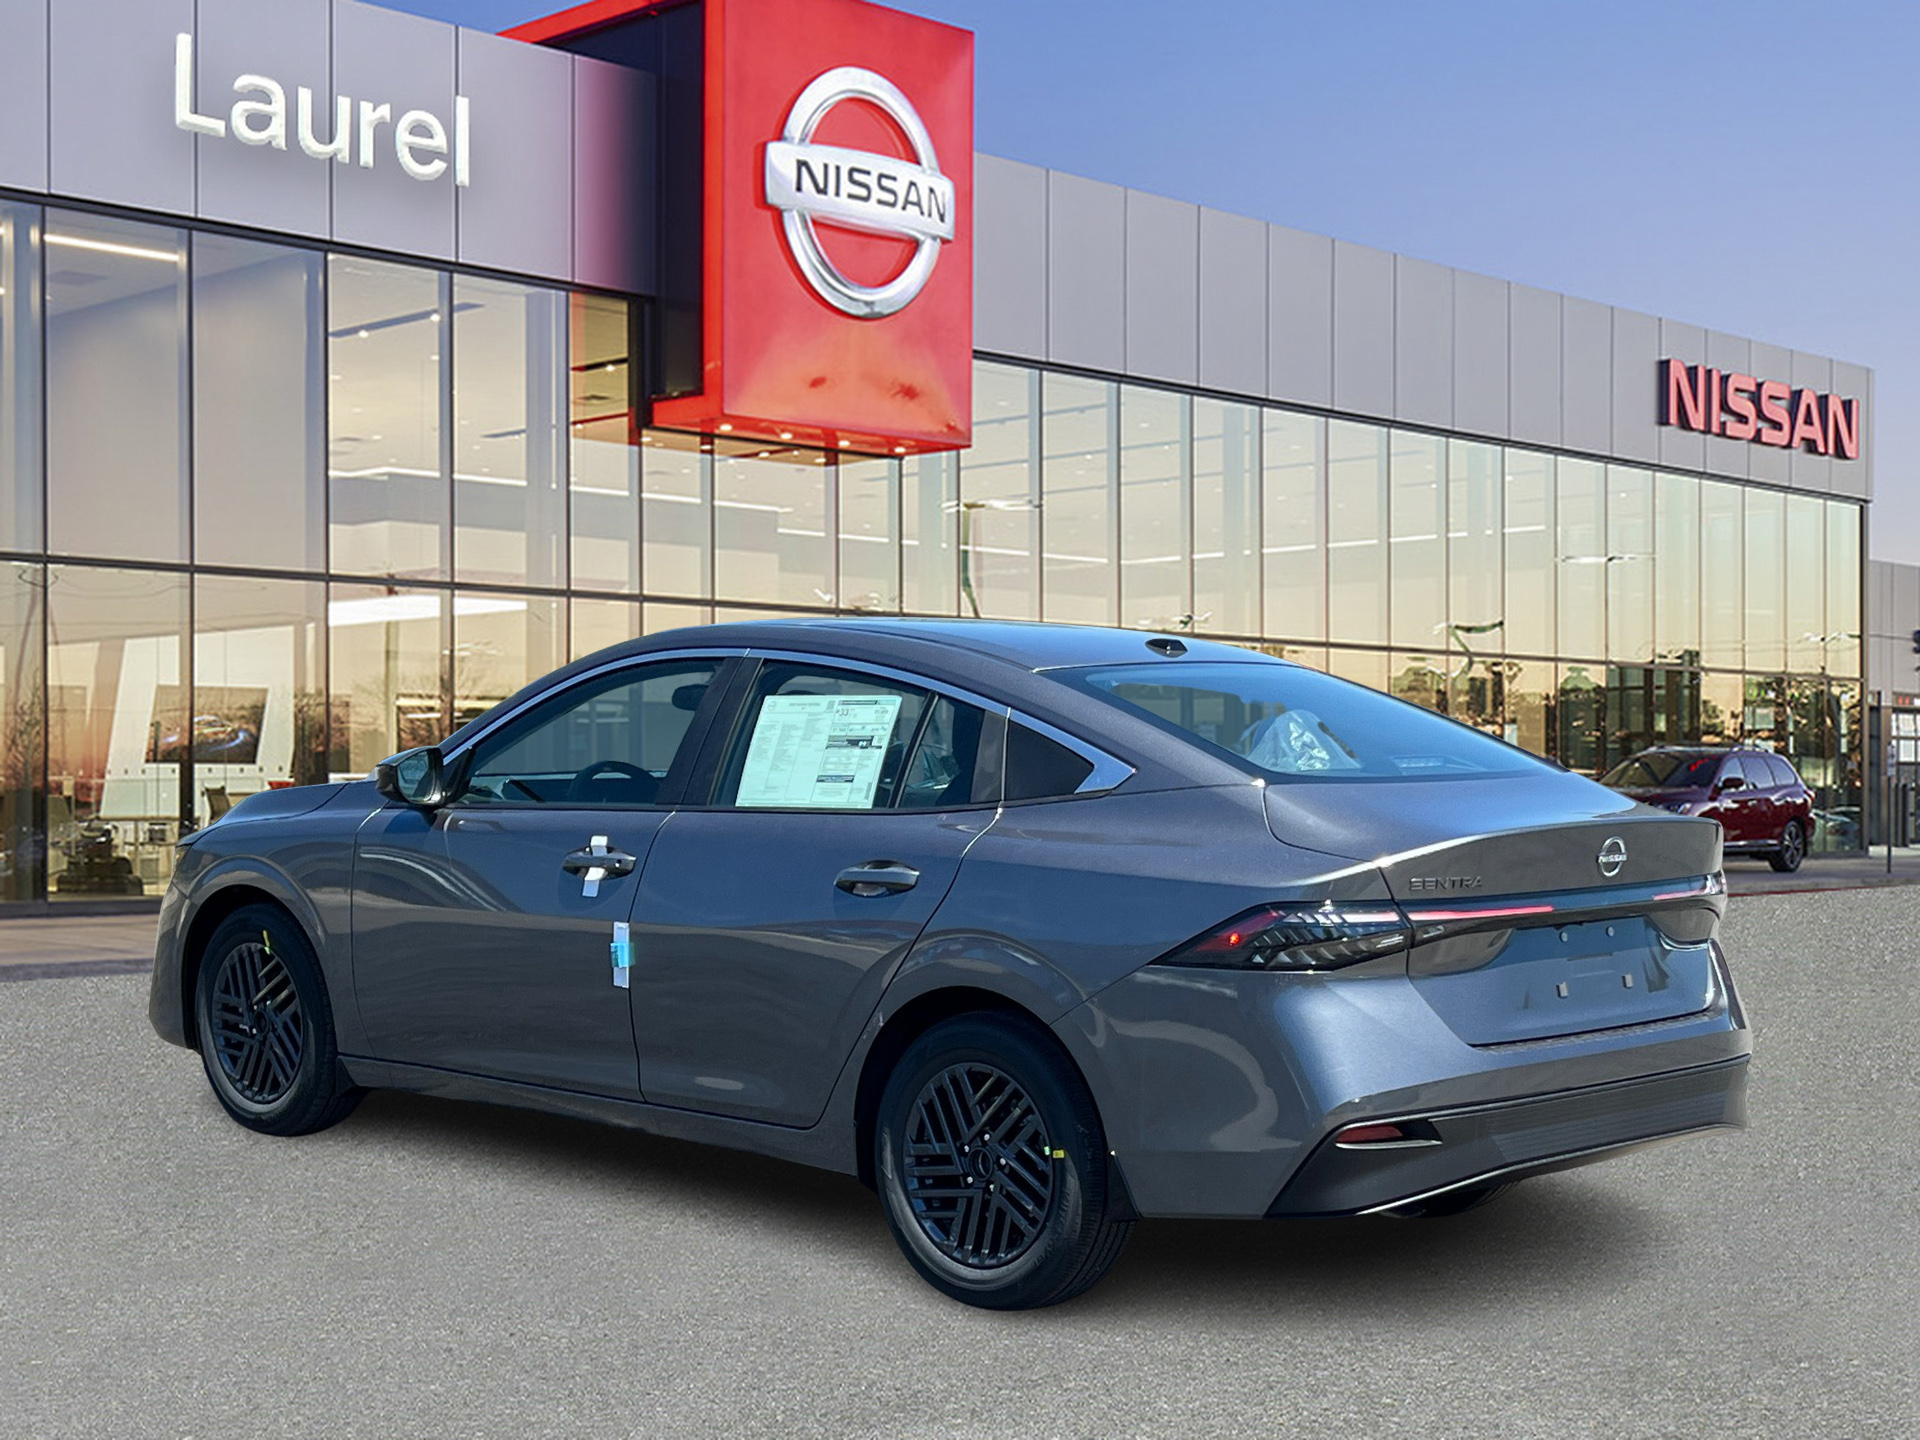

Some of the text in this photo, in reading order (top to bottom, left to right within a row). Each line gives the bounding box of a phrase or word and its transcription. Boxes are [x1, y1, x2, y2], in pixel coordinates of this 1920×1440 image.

[175, 32, 470, 187] Laurel
[795, 158, 946, 223] NISSAN
[1657, 358, 1860, 460] NISSAN
[1409, 875, 1482, 891] SENTRA
